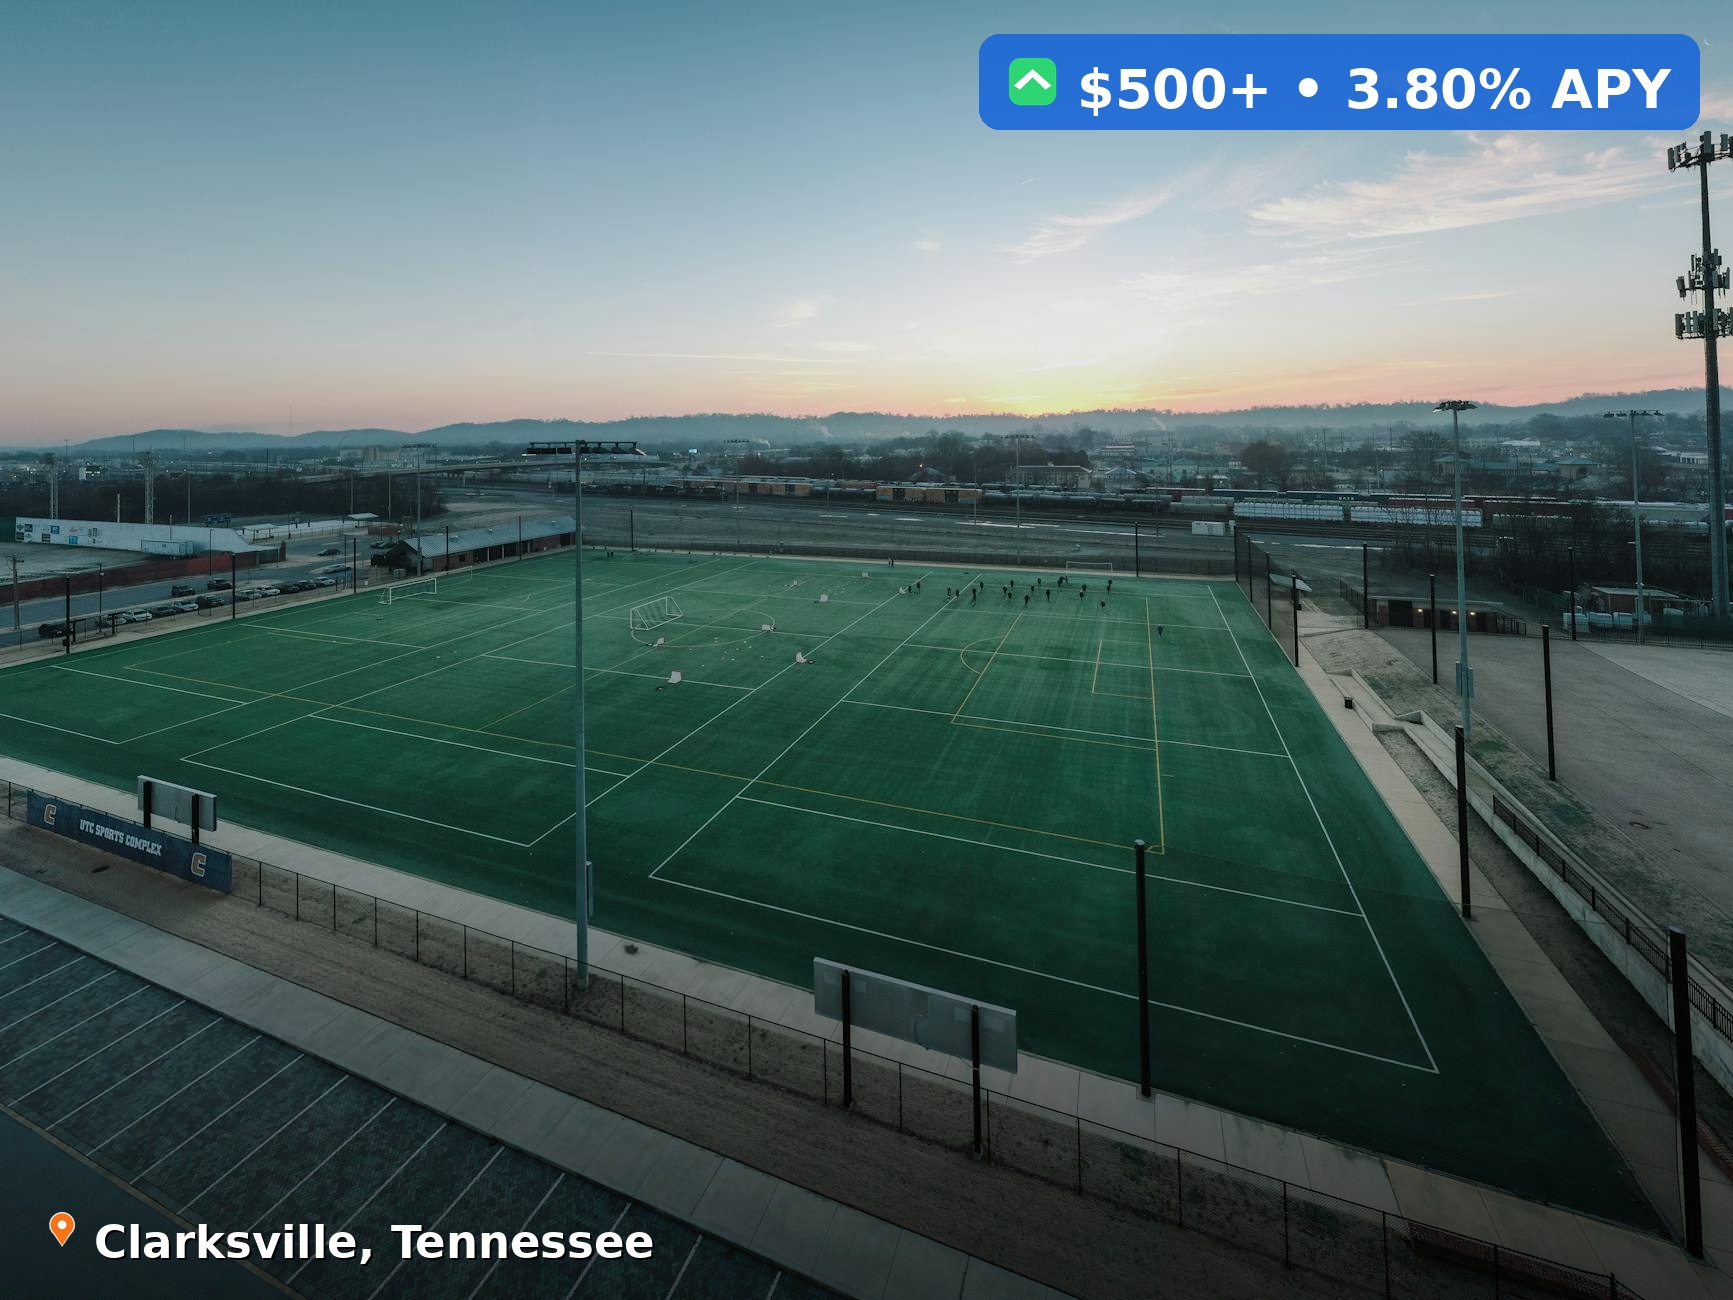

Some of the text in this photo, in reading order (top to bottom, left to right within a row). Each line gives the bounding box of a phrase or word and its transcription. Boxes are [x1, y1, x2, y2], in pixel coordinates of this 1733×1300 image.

[80, 819, 162, 857] UTC SPORTS COMPLEX
